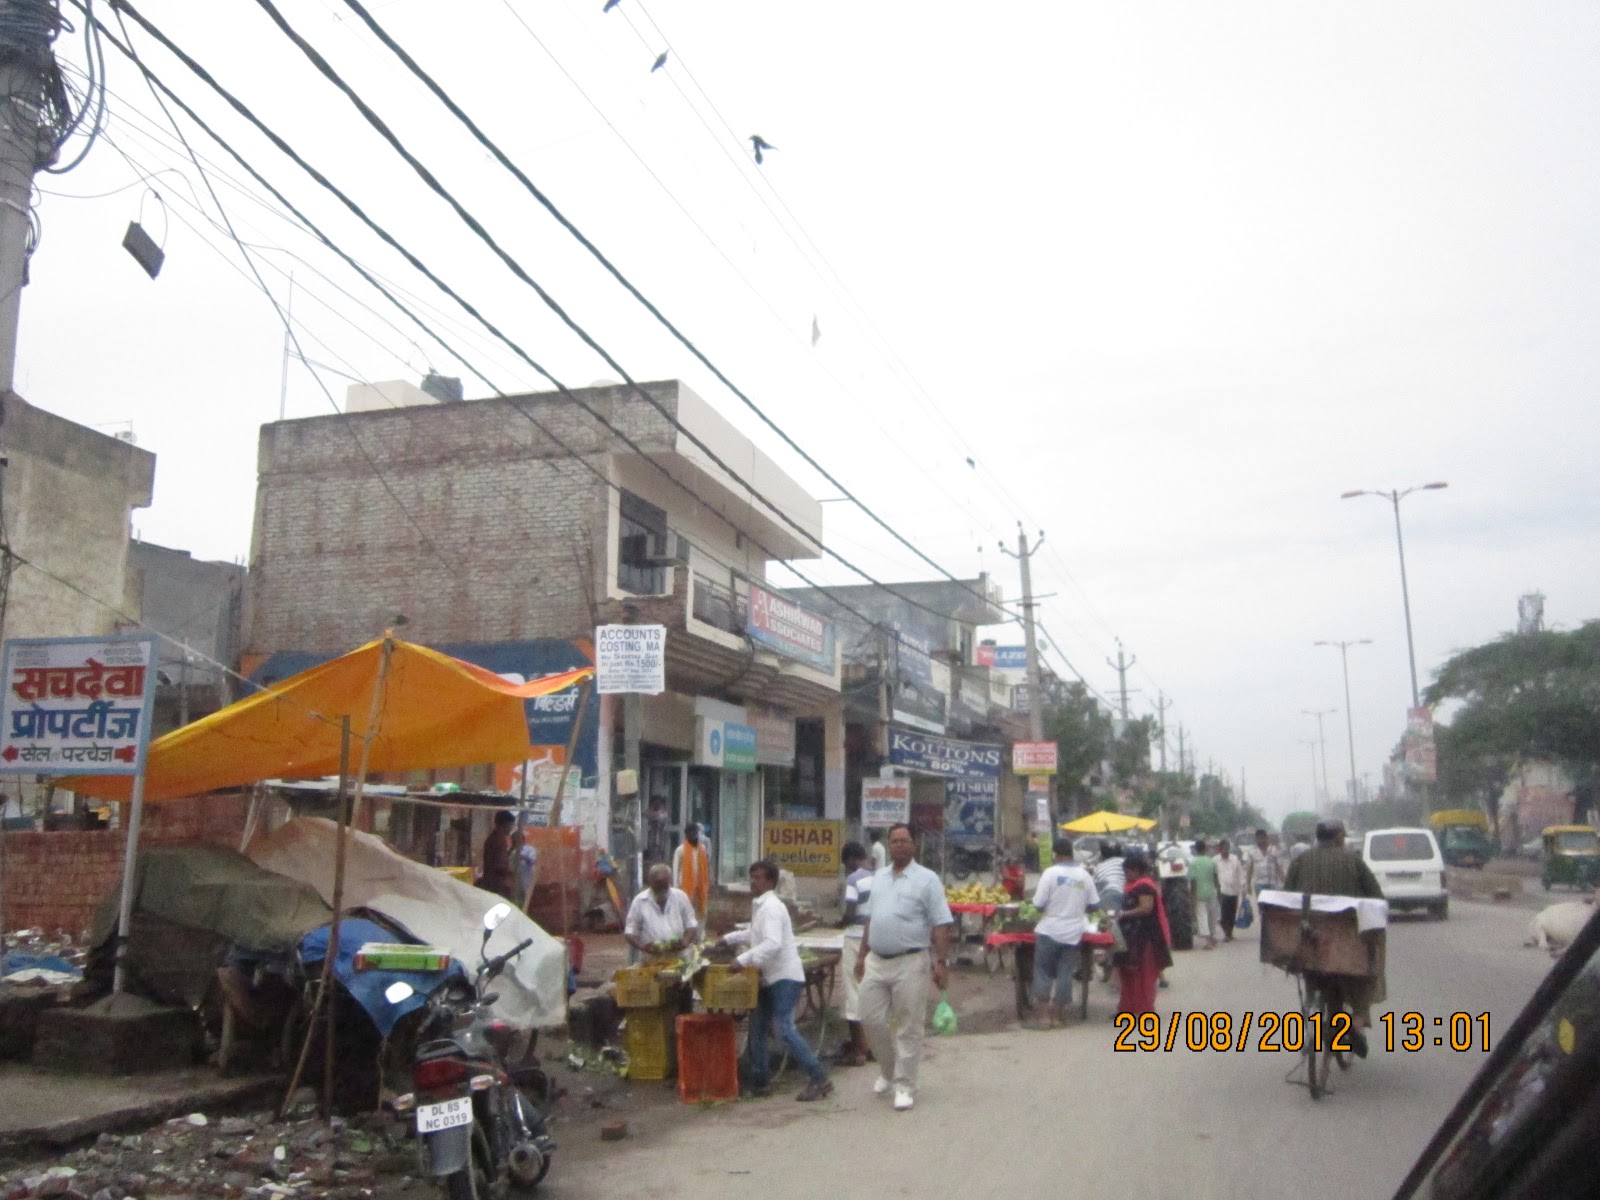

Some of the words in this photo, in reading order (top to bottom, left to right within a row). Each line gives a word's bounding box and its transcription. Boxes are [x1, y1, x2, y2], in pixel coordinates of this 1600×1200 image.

[600, 629, 661, 640] ACCOUNTS
[646, 641, 660, 651] MA
[12, 657, 147, 701] सचदेवा
[20, 742, 51, 762] सेल
[62, 742, 114, 762] परचेज
[892, 734, 1000, 766] KOUTONS
[931, 760, 964, 774] 80%
[765, 828, 833, 846] USHAR
[432, 1105, 444, 1117] DL
[447, 1101, 460, 1113] 8S
[425, 1119, 441, 1130] NC
[443, 1112, 467, 1127] 0319
